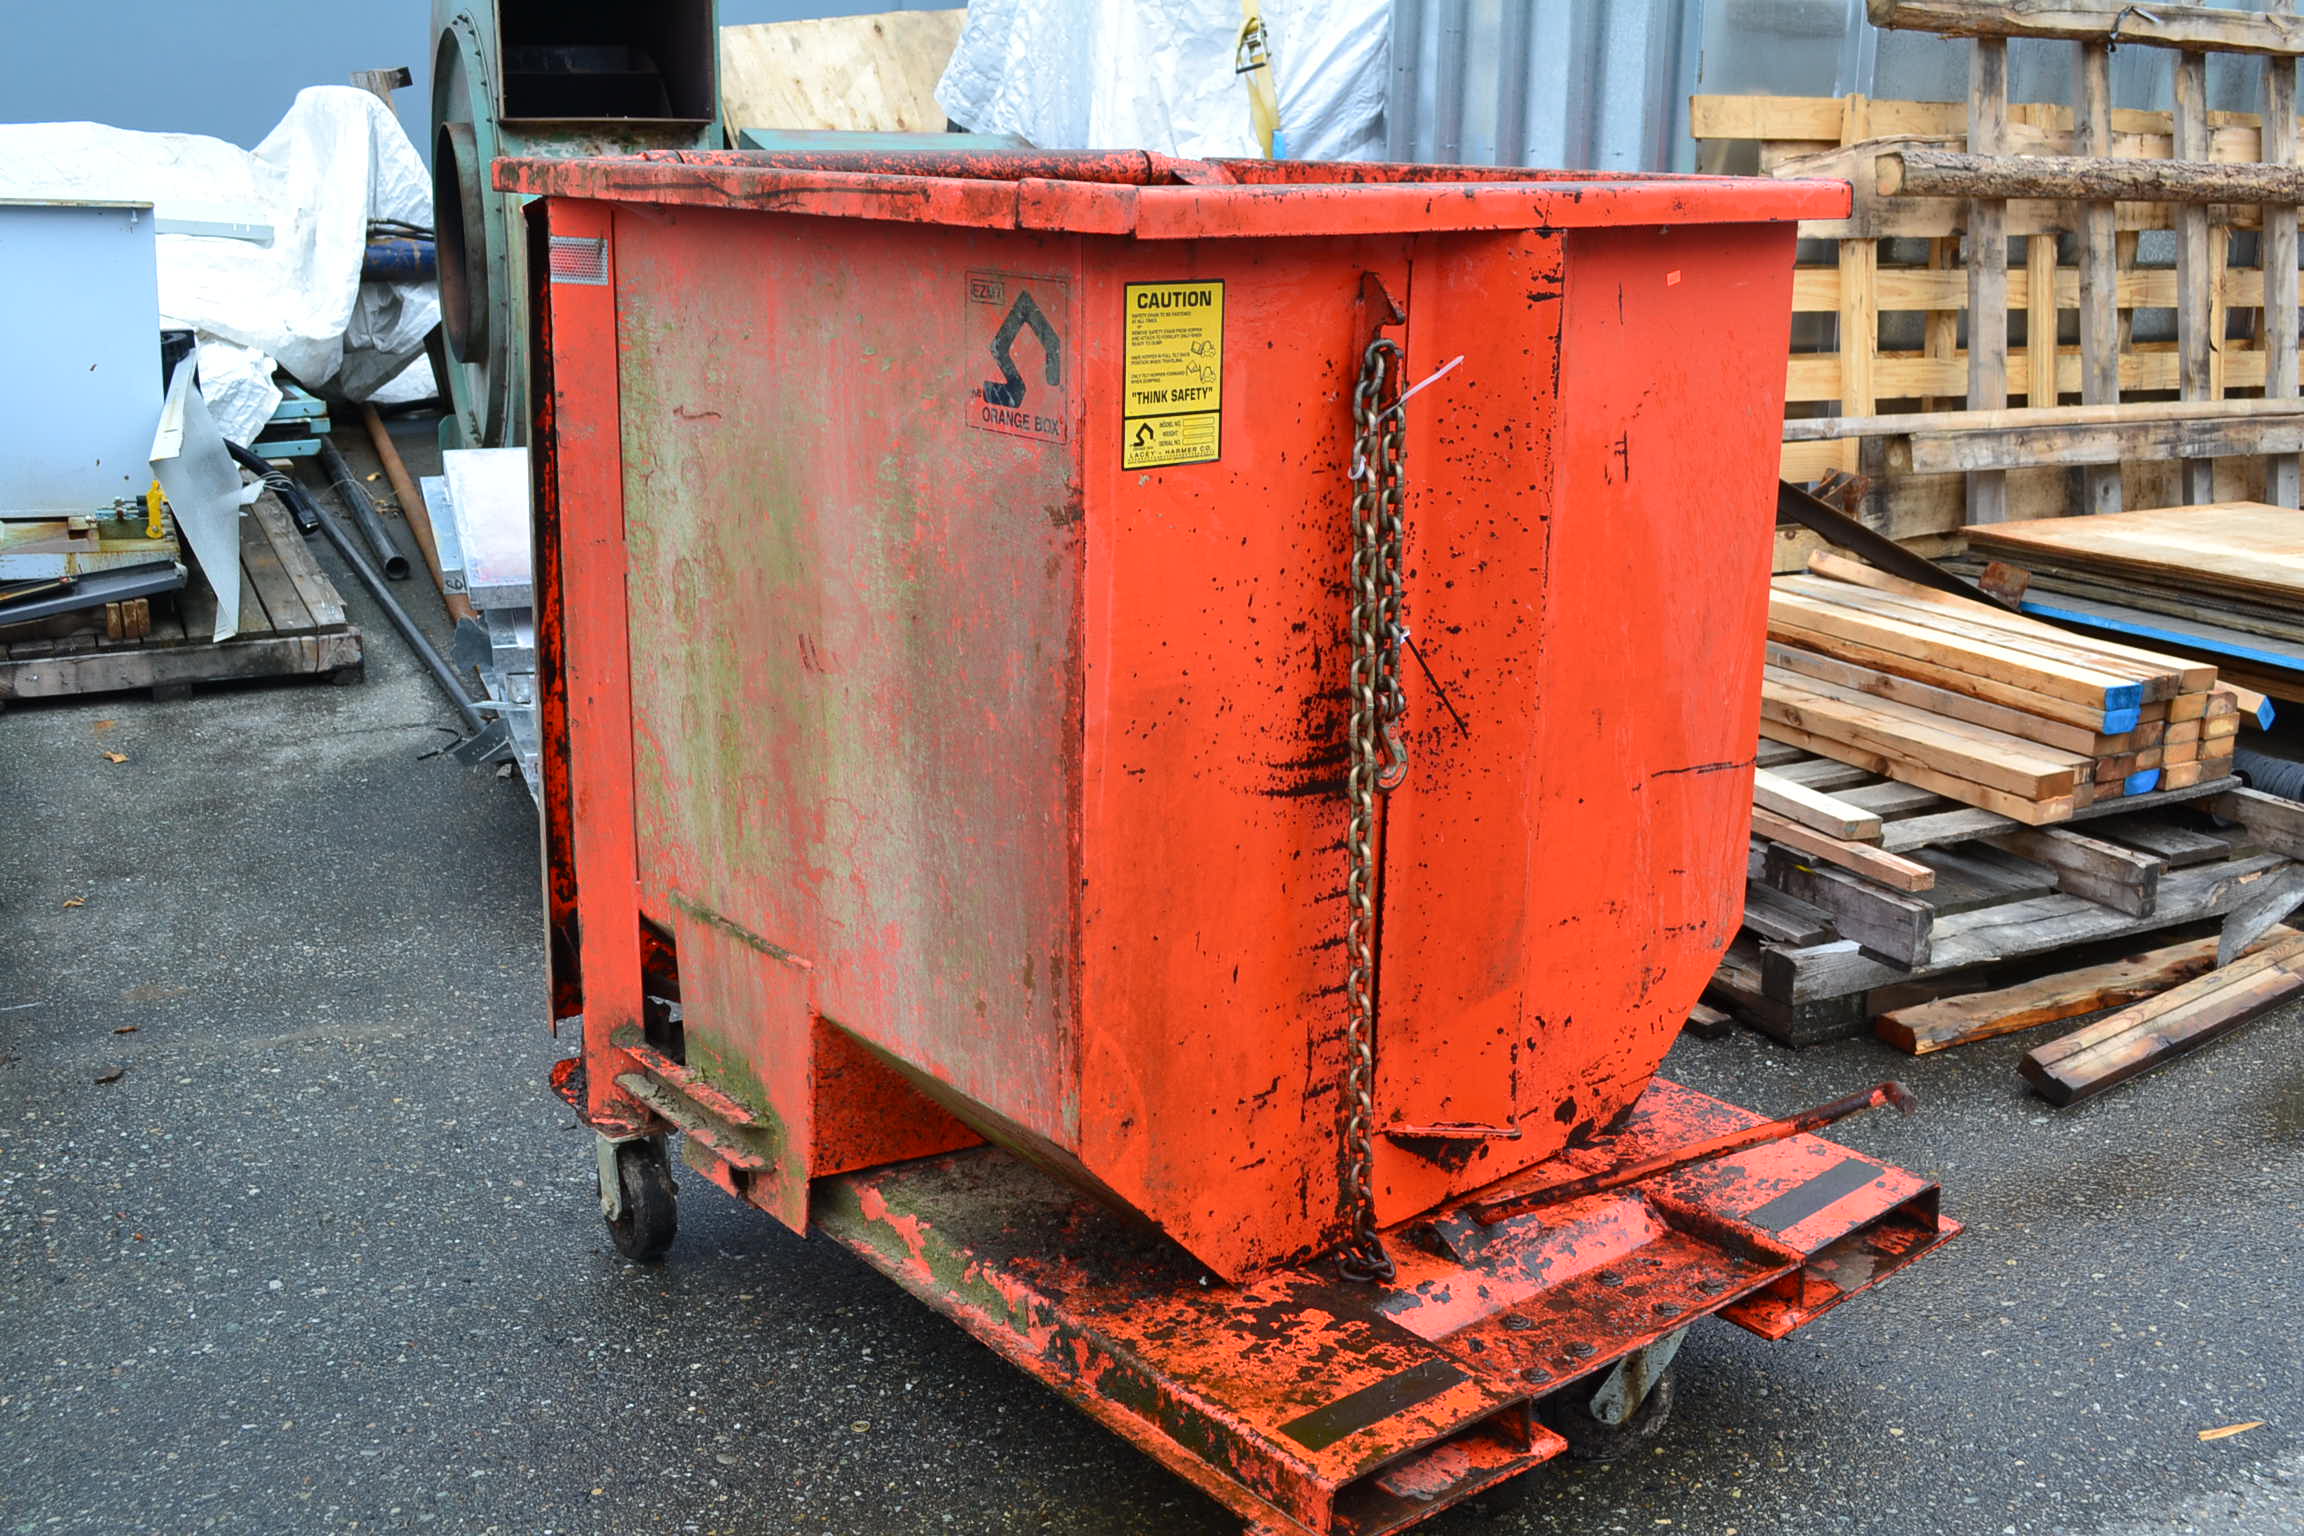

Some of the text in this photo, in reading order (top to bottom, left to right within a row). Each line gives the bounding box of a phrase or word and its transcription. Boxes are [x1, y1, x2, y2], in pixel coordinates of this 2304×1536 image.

[1137, 290, 1212, 309] CAUTION
[1132, 386, 1213, 405] "THINK SAFETY"
[982, 406, 1060, 435] ORANGE BOX
